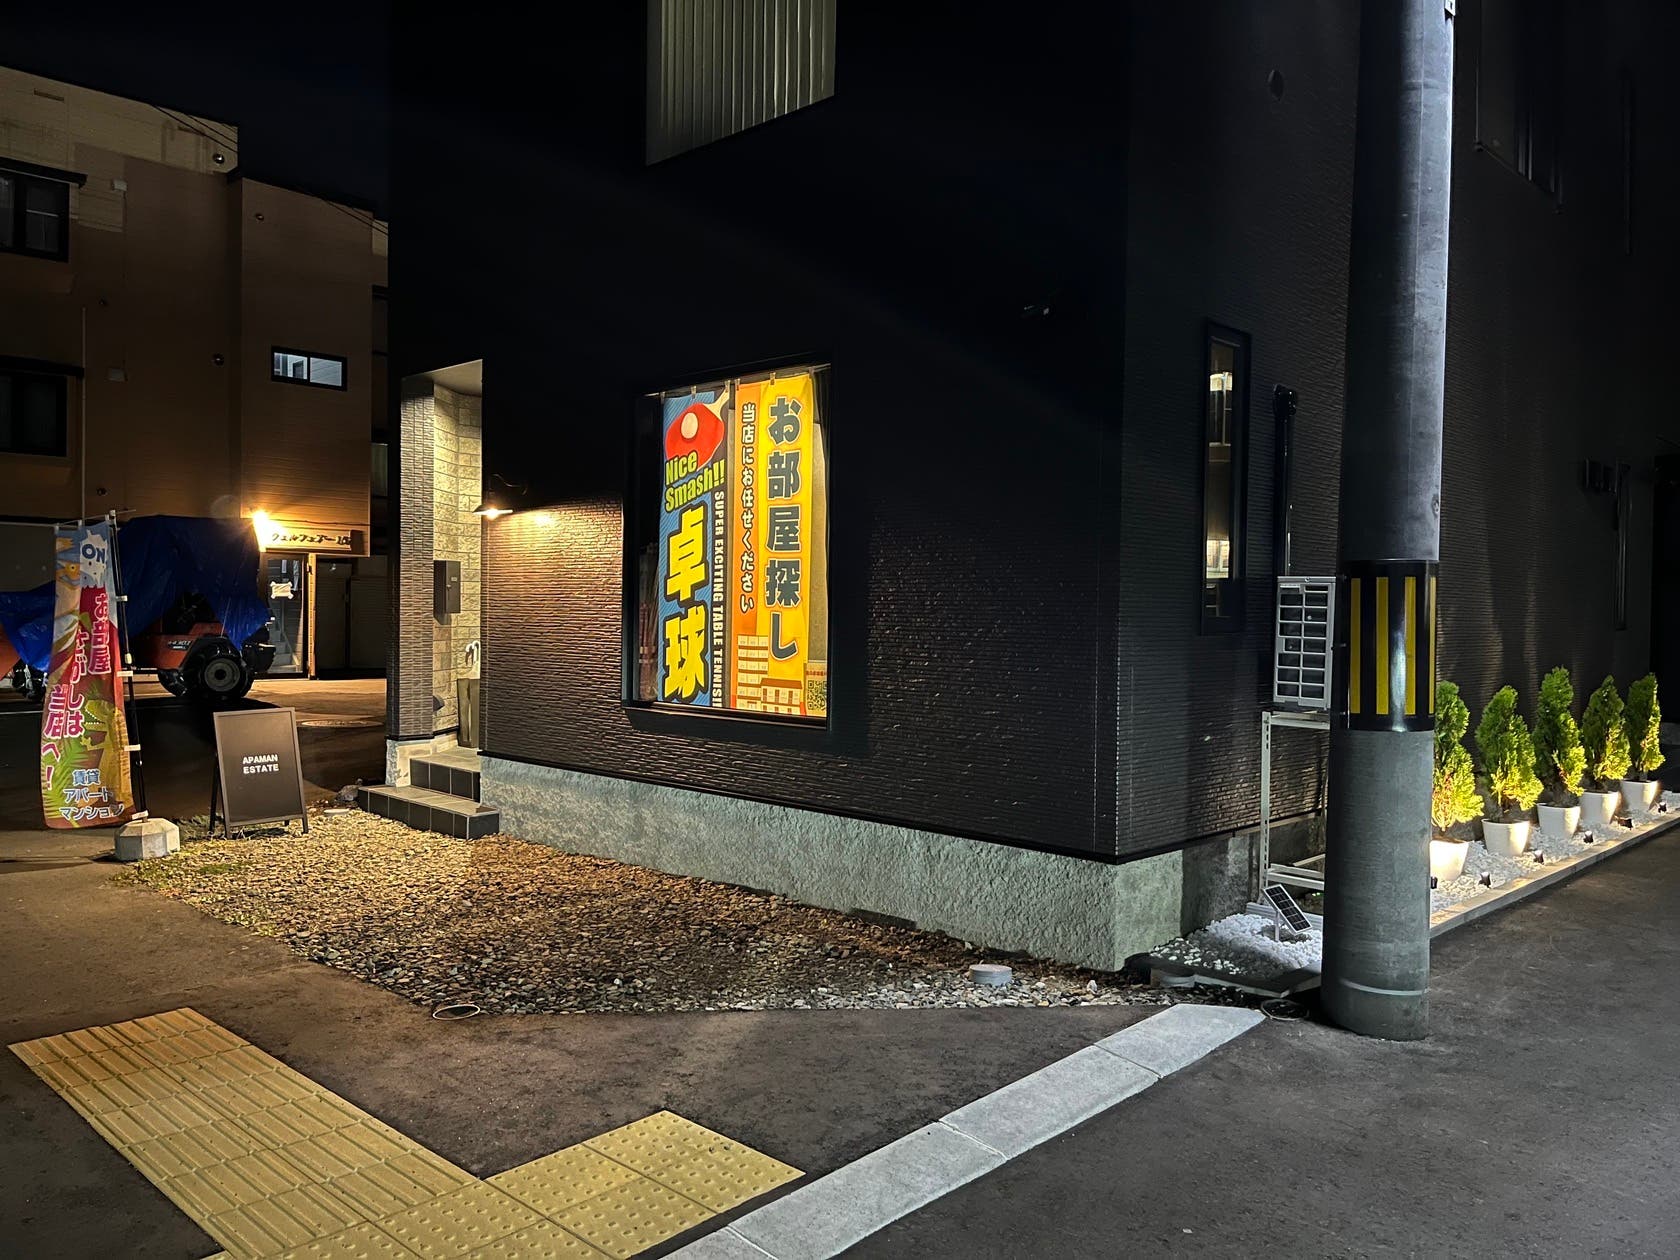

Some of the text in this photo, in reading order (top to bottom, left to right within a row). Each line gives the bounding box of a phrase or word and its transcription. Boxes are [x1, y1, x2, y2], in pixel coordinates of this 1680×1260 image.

[665, 452, 698, 486] Nice
[665, 459, 726, 512] Smash!!
[740, 402, 756, 613] 当店にお任せください
[766, 396, 802, 660] お部屋探し
[664, 505, 706, 698] 卓球
[711, 491, 725, 708] SUPER EXCITING TABLE TENNIS!!
[242, 754, 279, 765] APAMAN
[243, 763, 279, 774] ESTATE
[72, 769, 101, 786] 賃貸
[60, 803, 125, 820] マンション
[64, 787, 112, 803] アパート
